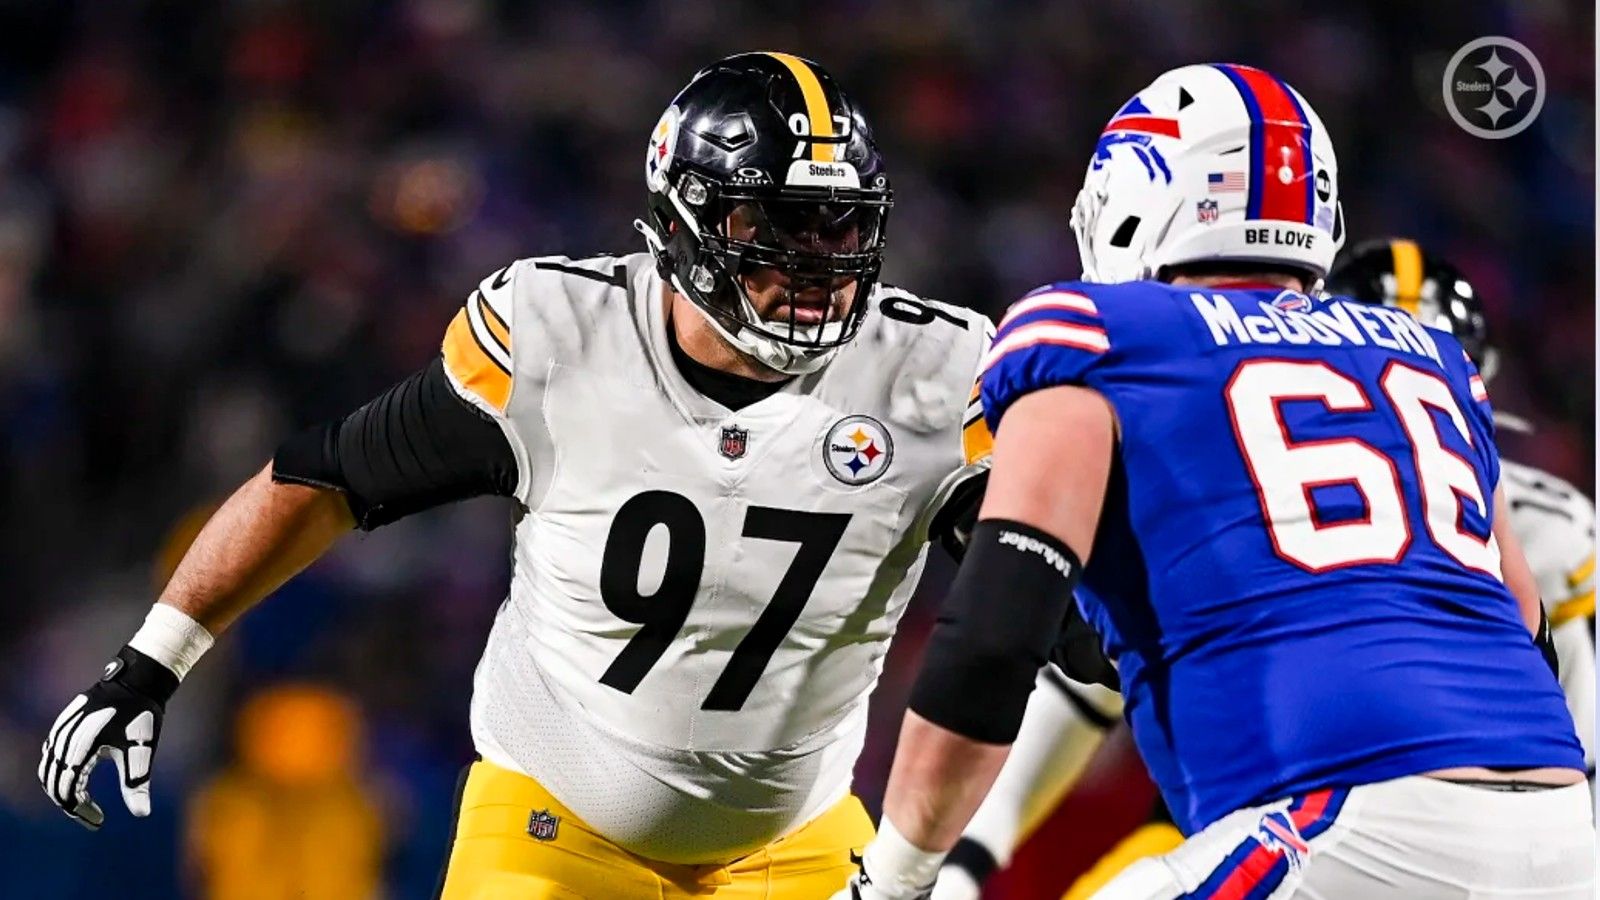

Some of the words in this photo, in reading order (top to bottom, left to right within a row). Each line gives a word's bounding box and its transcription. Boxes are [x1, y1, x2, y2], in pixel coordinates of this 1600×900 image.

[788, 113, 851, 160] 97
[809, 164, 846, 178] Steelers
[1245, 228, 1269, 244] BE
[1274, 231, 1315, 249] LOVE
[1190, 292, 1444, 369] McGOVERN
[1223, 357, 1503, 583] 66
[598, 489, 854, 711] 97
